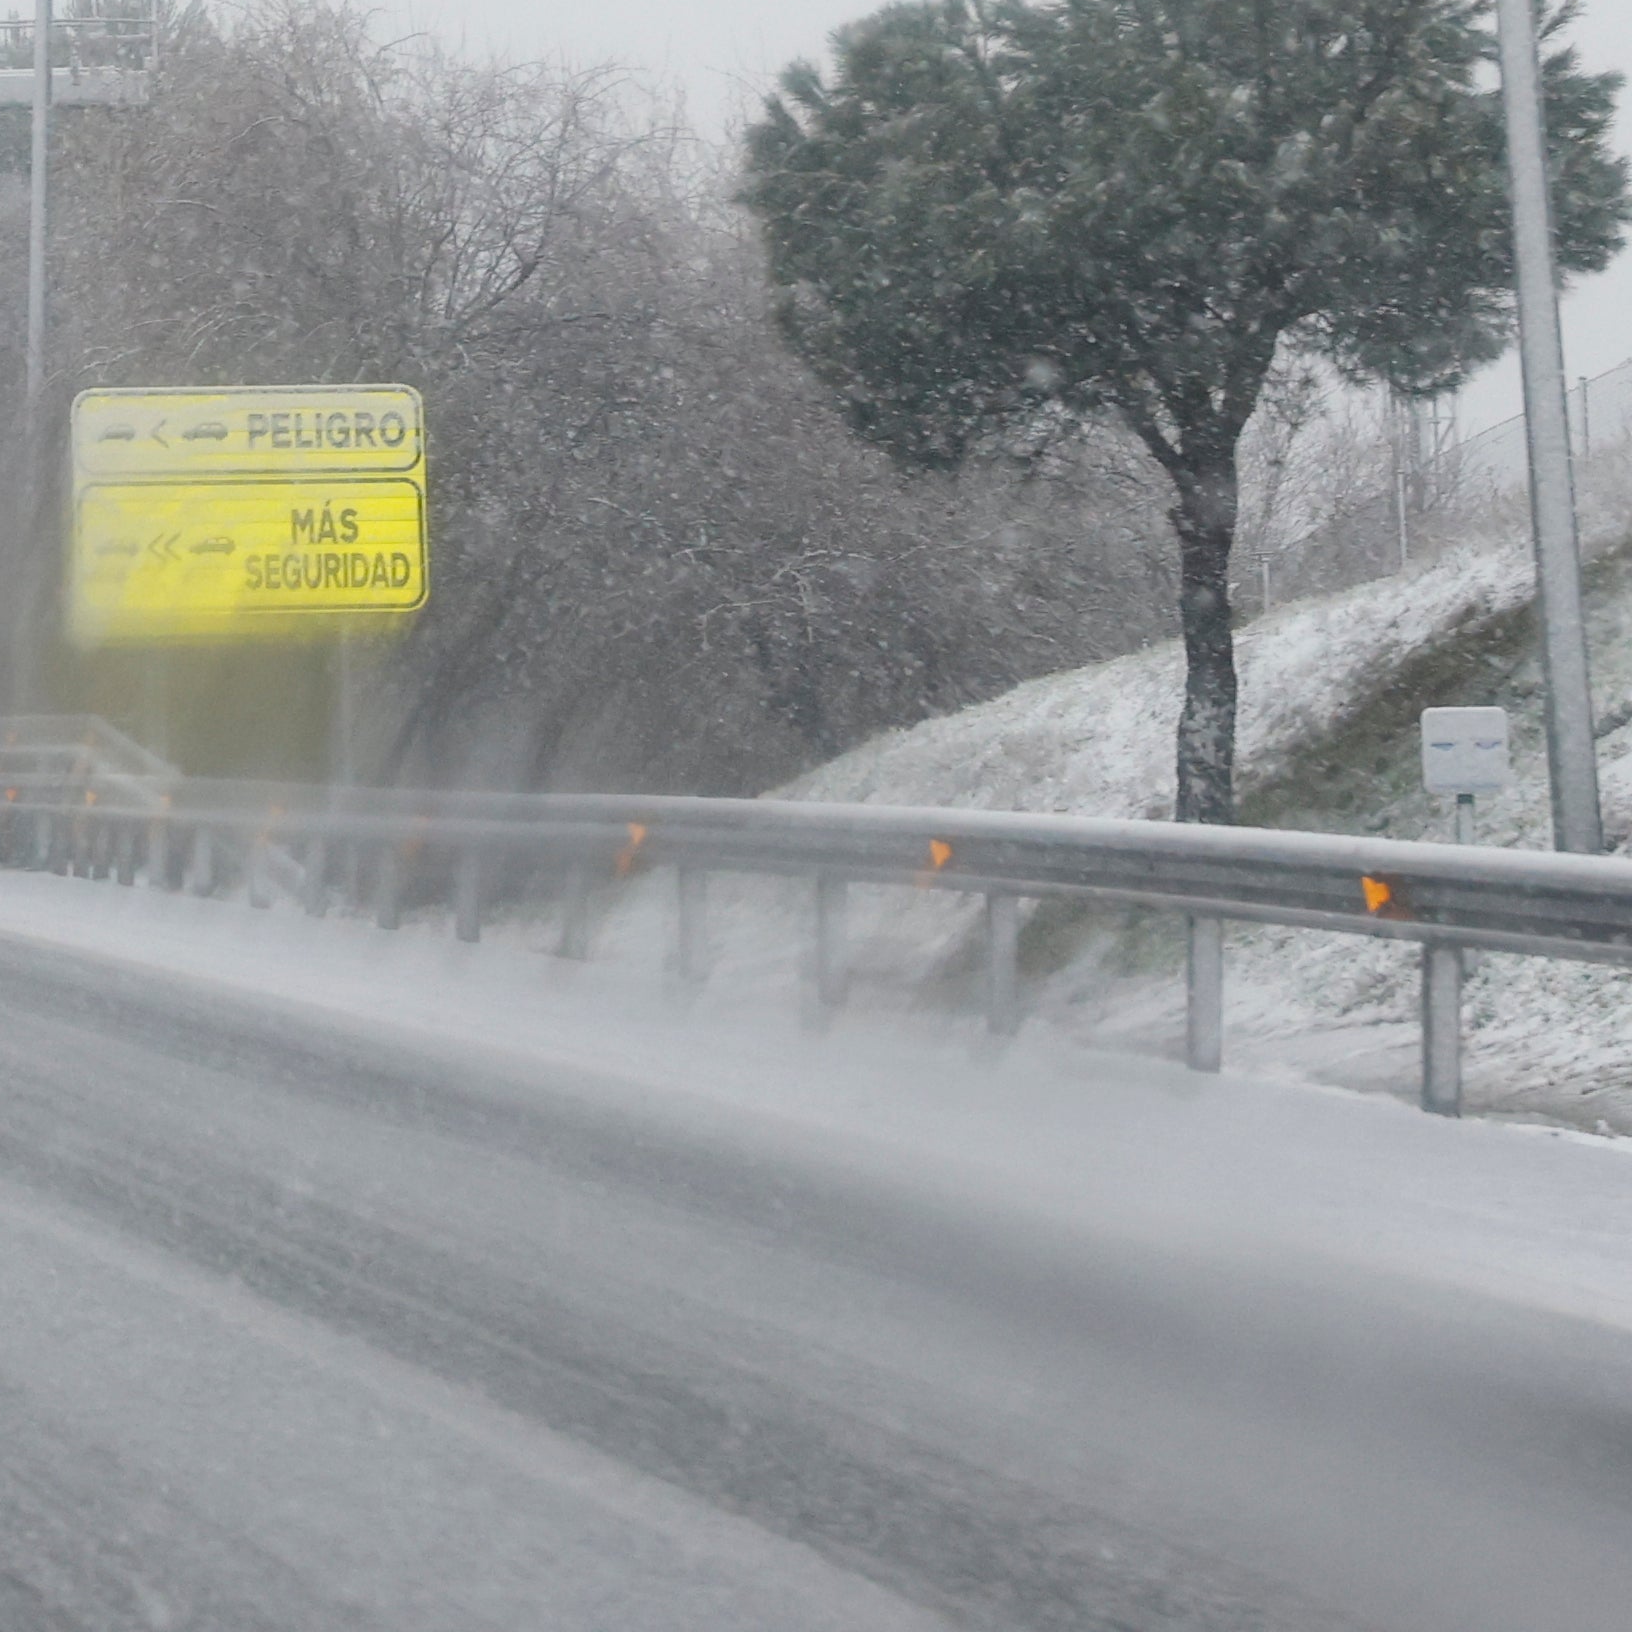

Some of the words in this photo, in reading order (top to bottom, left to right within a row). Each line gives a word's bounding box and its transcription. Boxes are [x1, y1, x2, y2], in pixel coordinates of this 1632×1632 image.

[246, 410, 405, 449] PELIGRO
[290, 499, 359, 544] MÁS
[244, 551, 411, 590] SEGURIDAD
